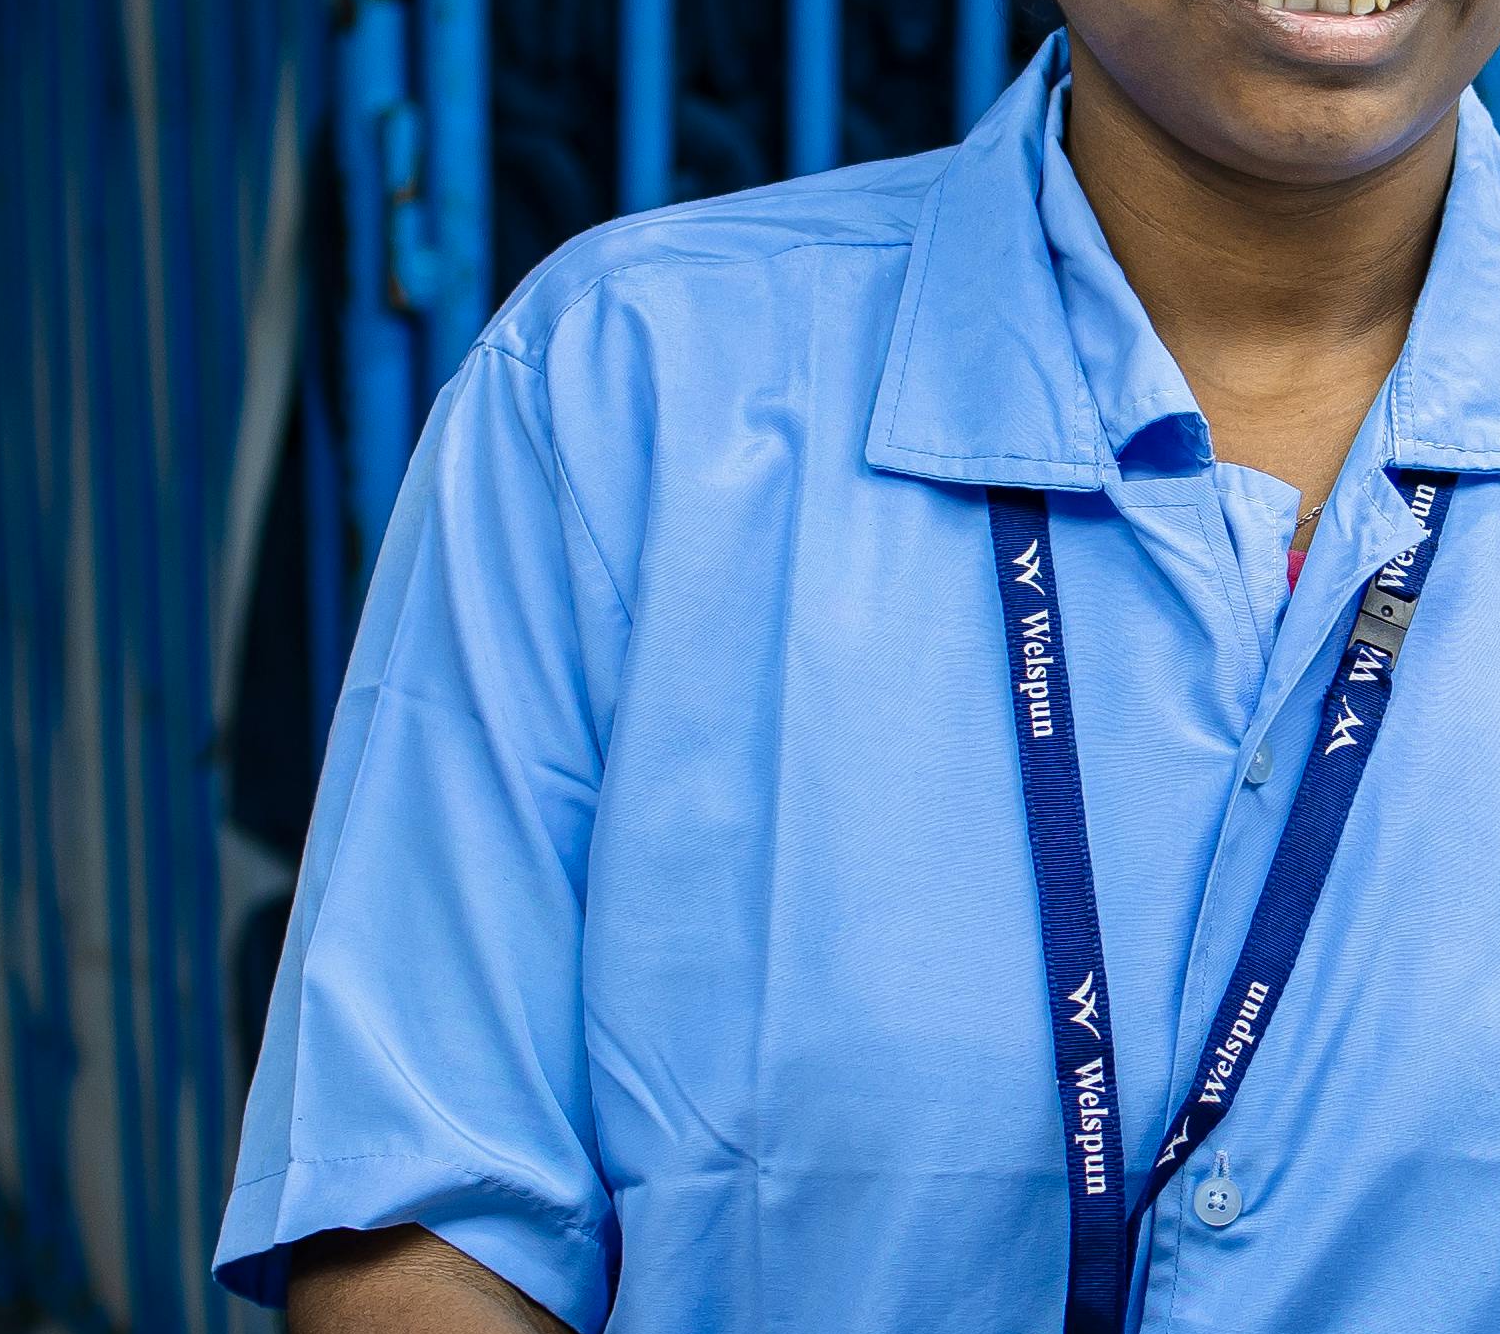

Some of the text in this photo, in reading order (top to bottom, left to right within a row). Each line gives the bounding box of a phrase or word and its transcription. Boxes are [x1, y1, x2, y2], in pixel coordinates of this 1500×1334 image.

[1020, 609, 1054, 738] Welspun
[1198, 980, 1270, 1103] Welspun
[1074, 1057, 1109, 1195] Welspun
